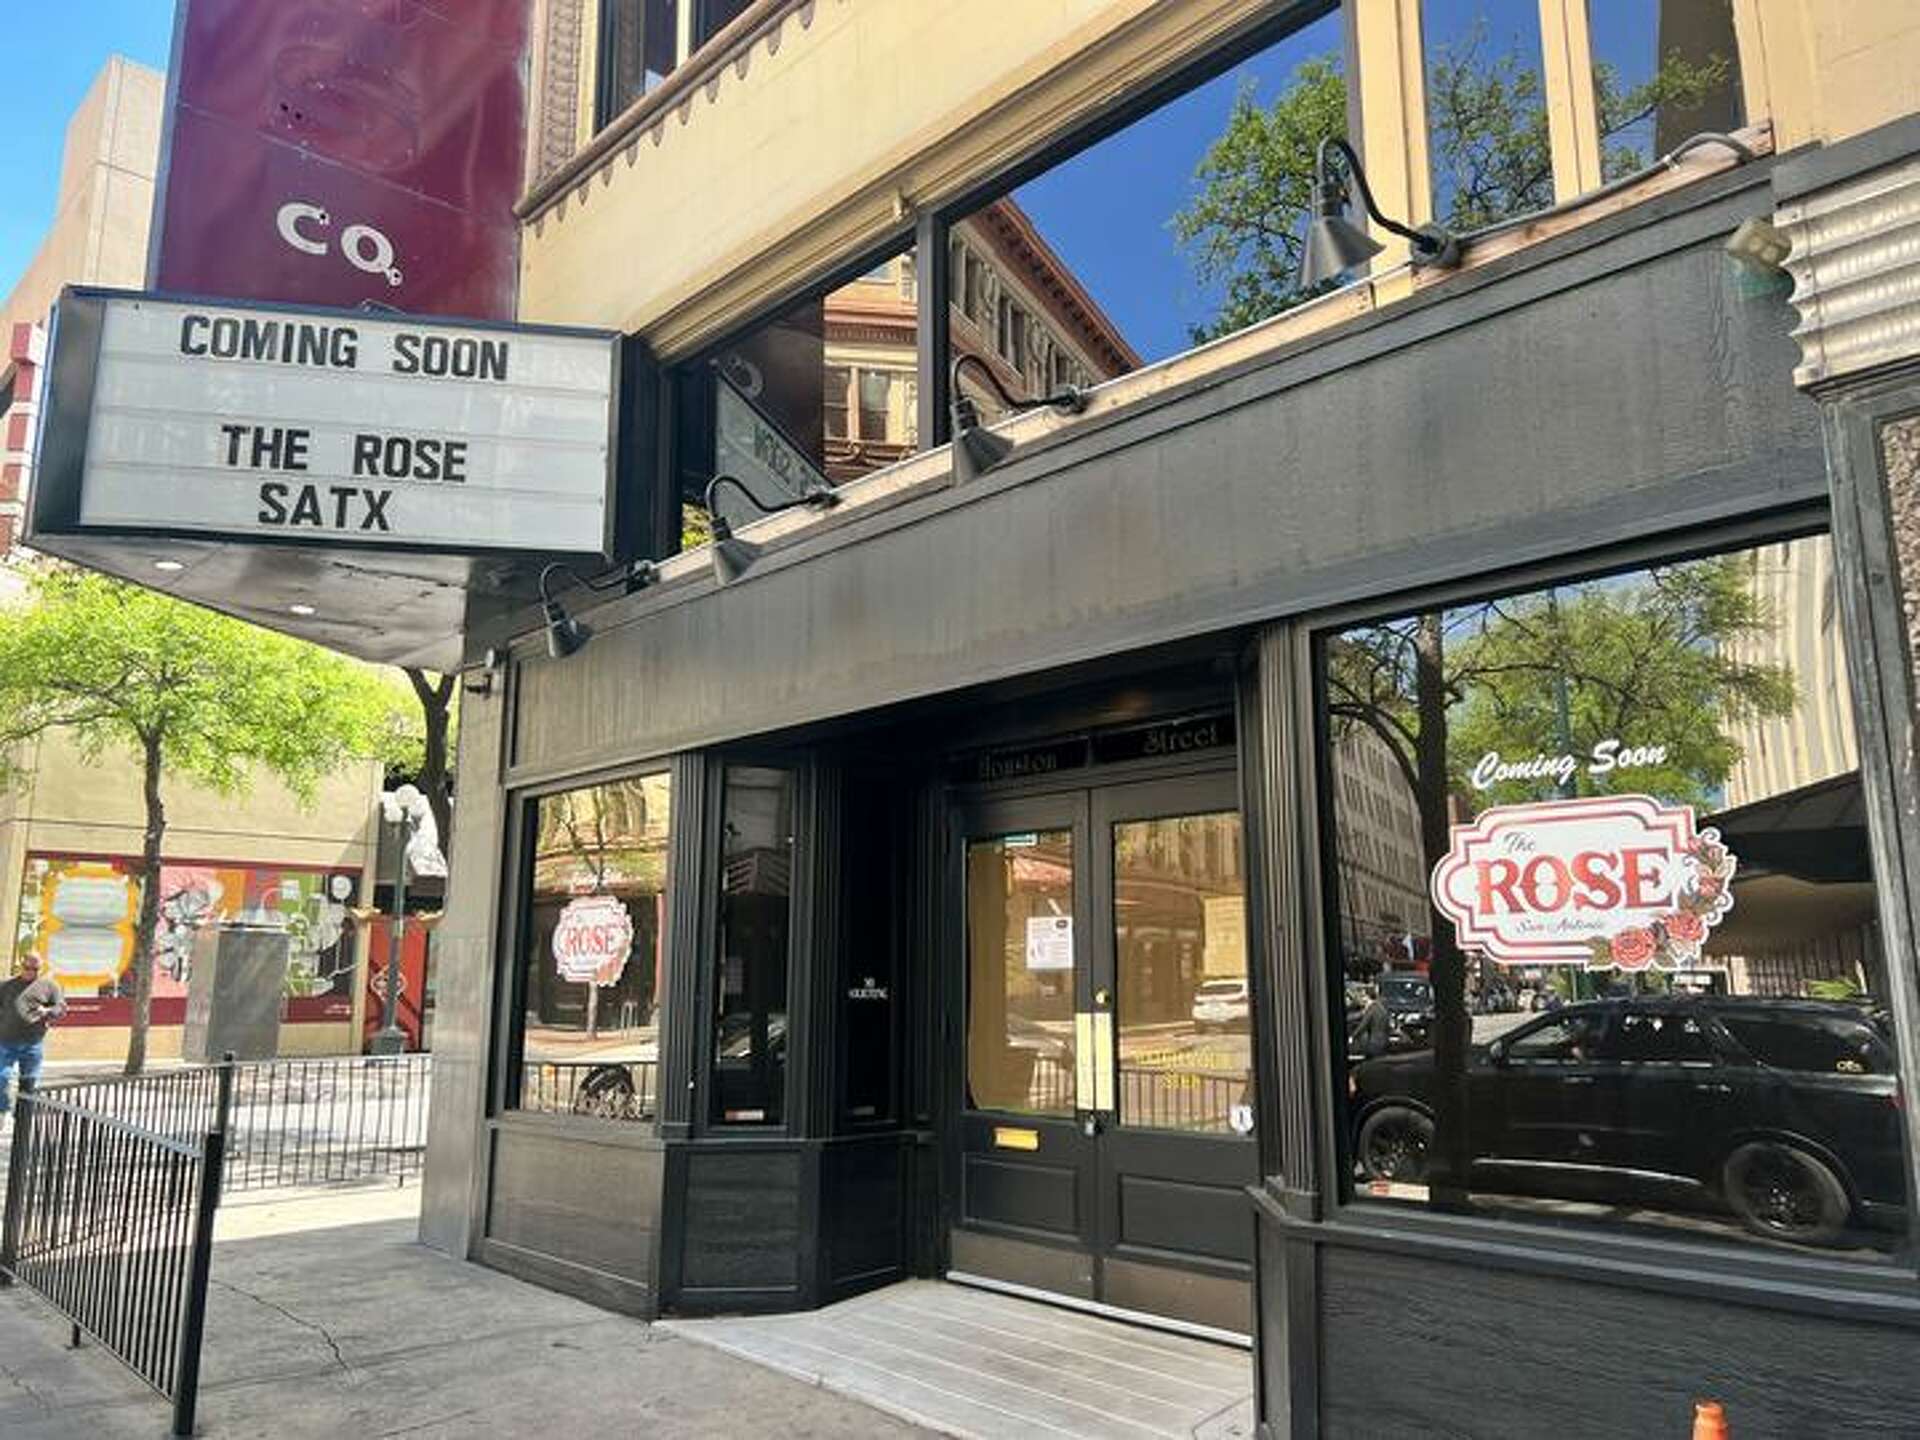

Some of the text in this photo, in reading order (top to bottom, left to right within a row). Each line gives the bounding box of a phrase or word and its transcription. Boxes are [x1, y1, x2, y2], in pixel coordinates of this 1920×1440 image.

[180, 315, 508, 380] COMING SOON
[222, 425, 467, 482] THE ROSE
[258, 483, 392, 531] SATX
[1472, 739, 1667, 789] Coming Soon
[1503, 832, 1535, 853] The
[1475, 848, 1673, 915] ROSE
[564, 923, 616, 957] ROSE
